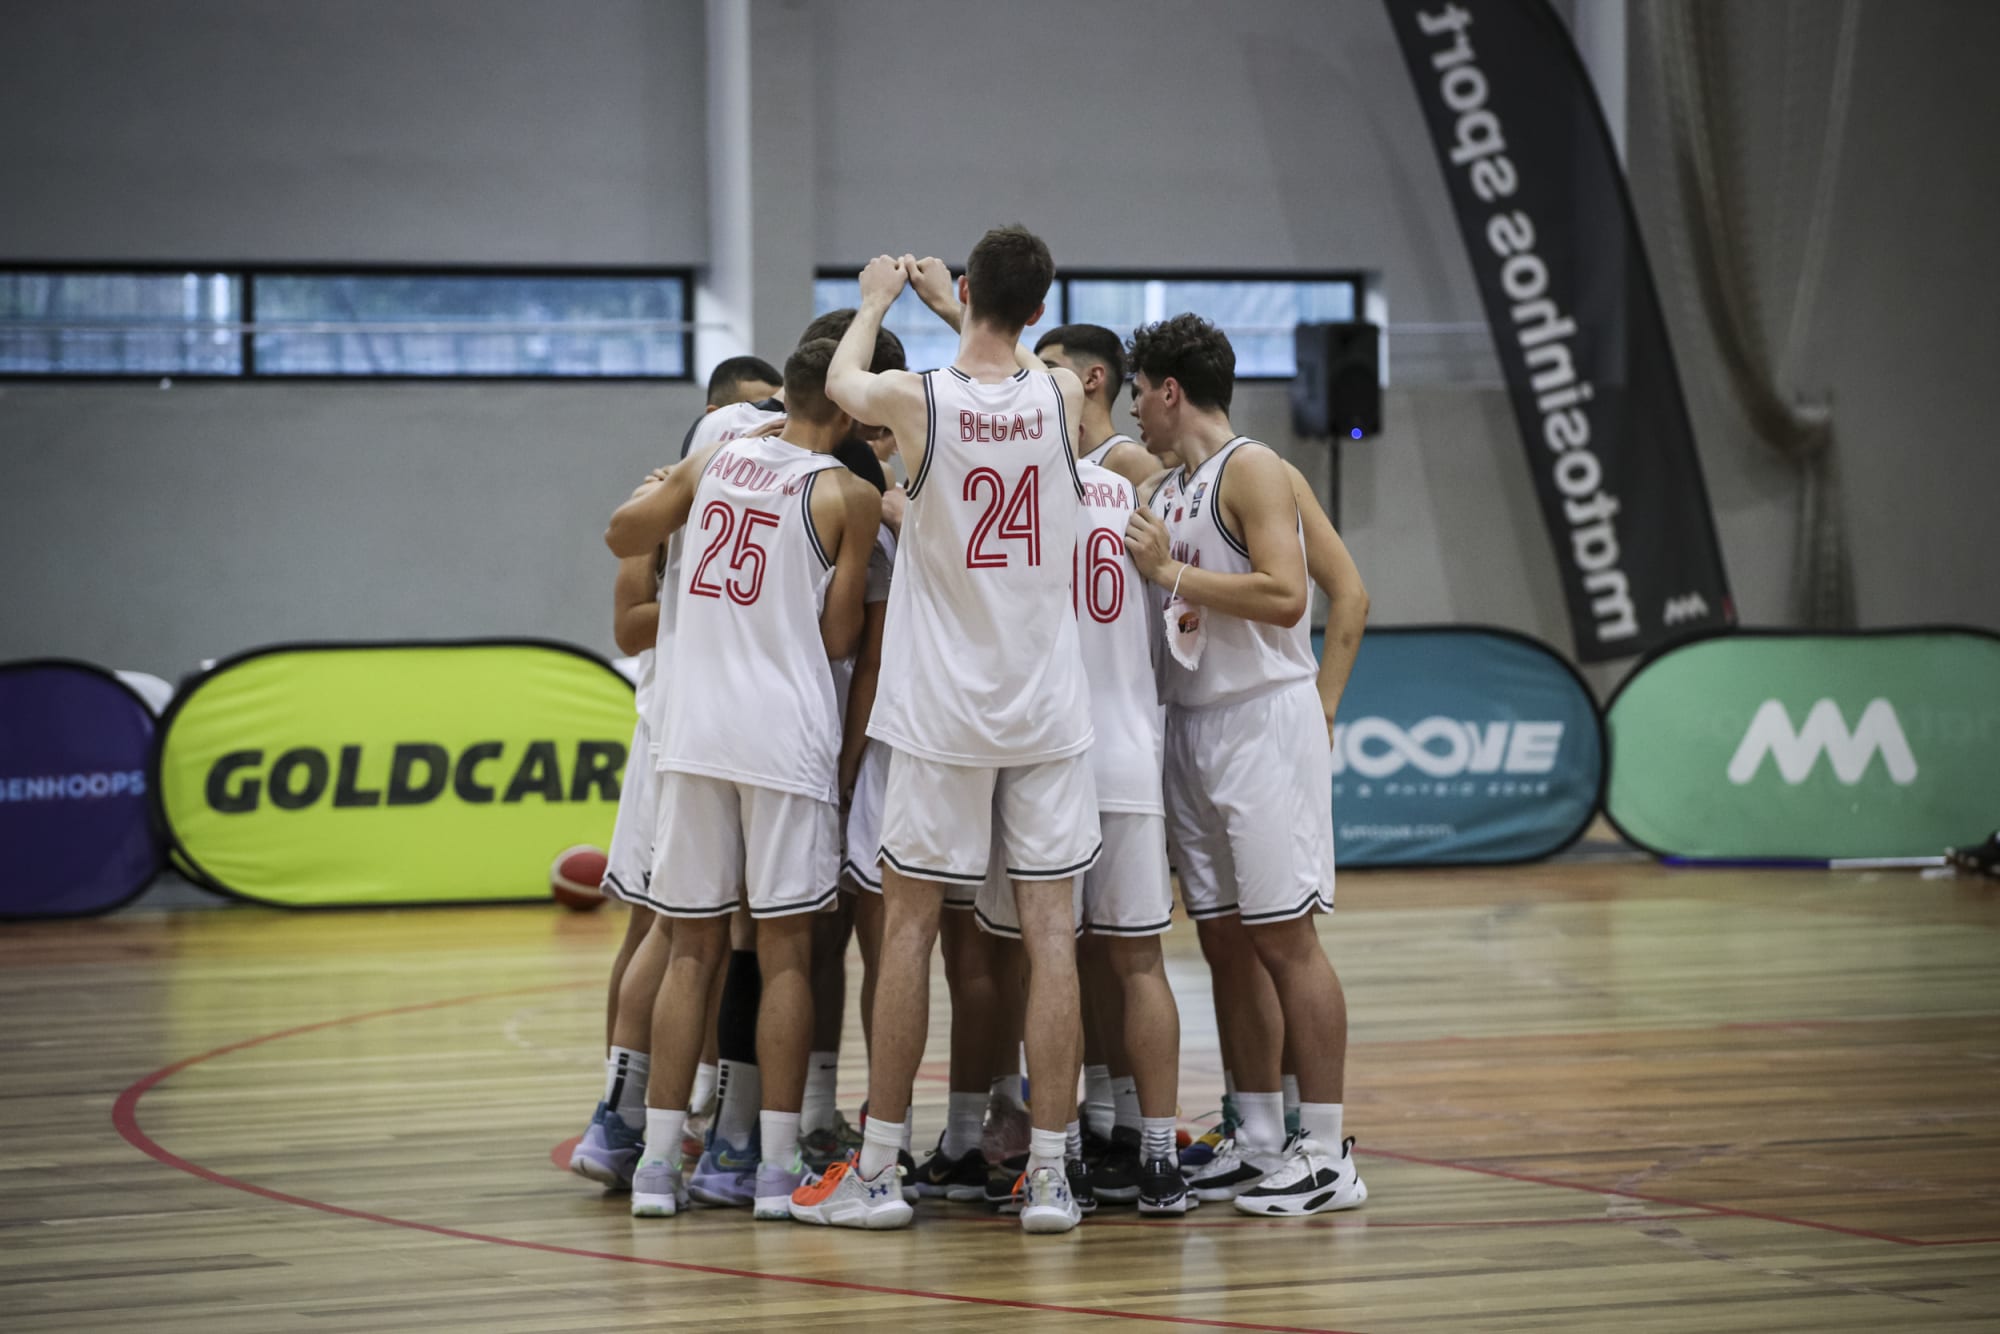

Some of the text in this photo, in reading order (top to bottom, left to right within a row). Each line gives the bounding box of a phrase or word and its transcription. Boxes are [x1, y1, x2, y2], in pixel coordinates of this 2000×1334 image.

[959, 408, 1043, 443] BEGAJ
[962, 465, 1041, 569] 24
[1081, 481, 1130, 510] RRA
[689, 500, 781, 606] 25
[204, 738, 630, 815] GOLDCAR
